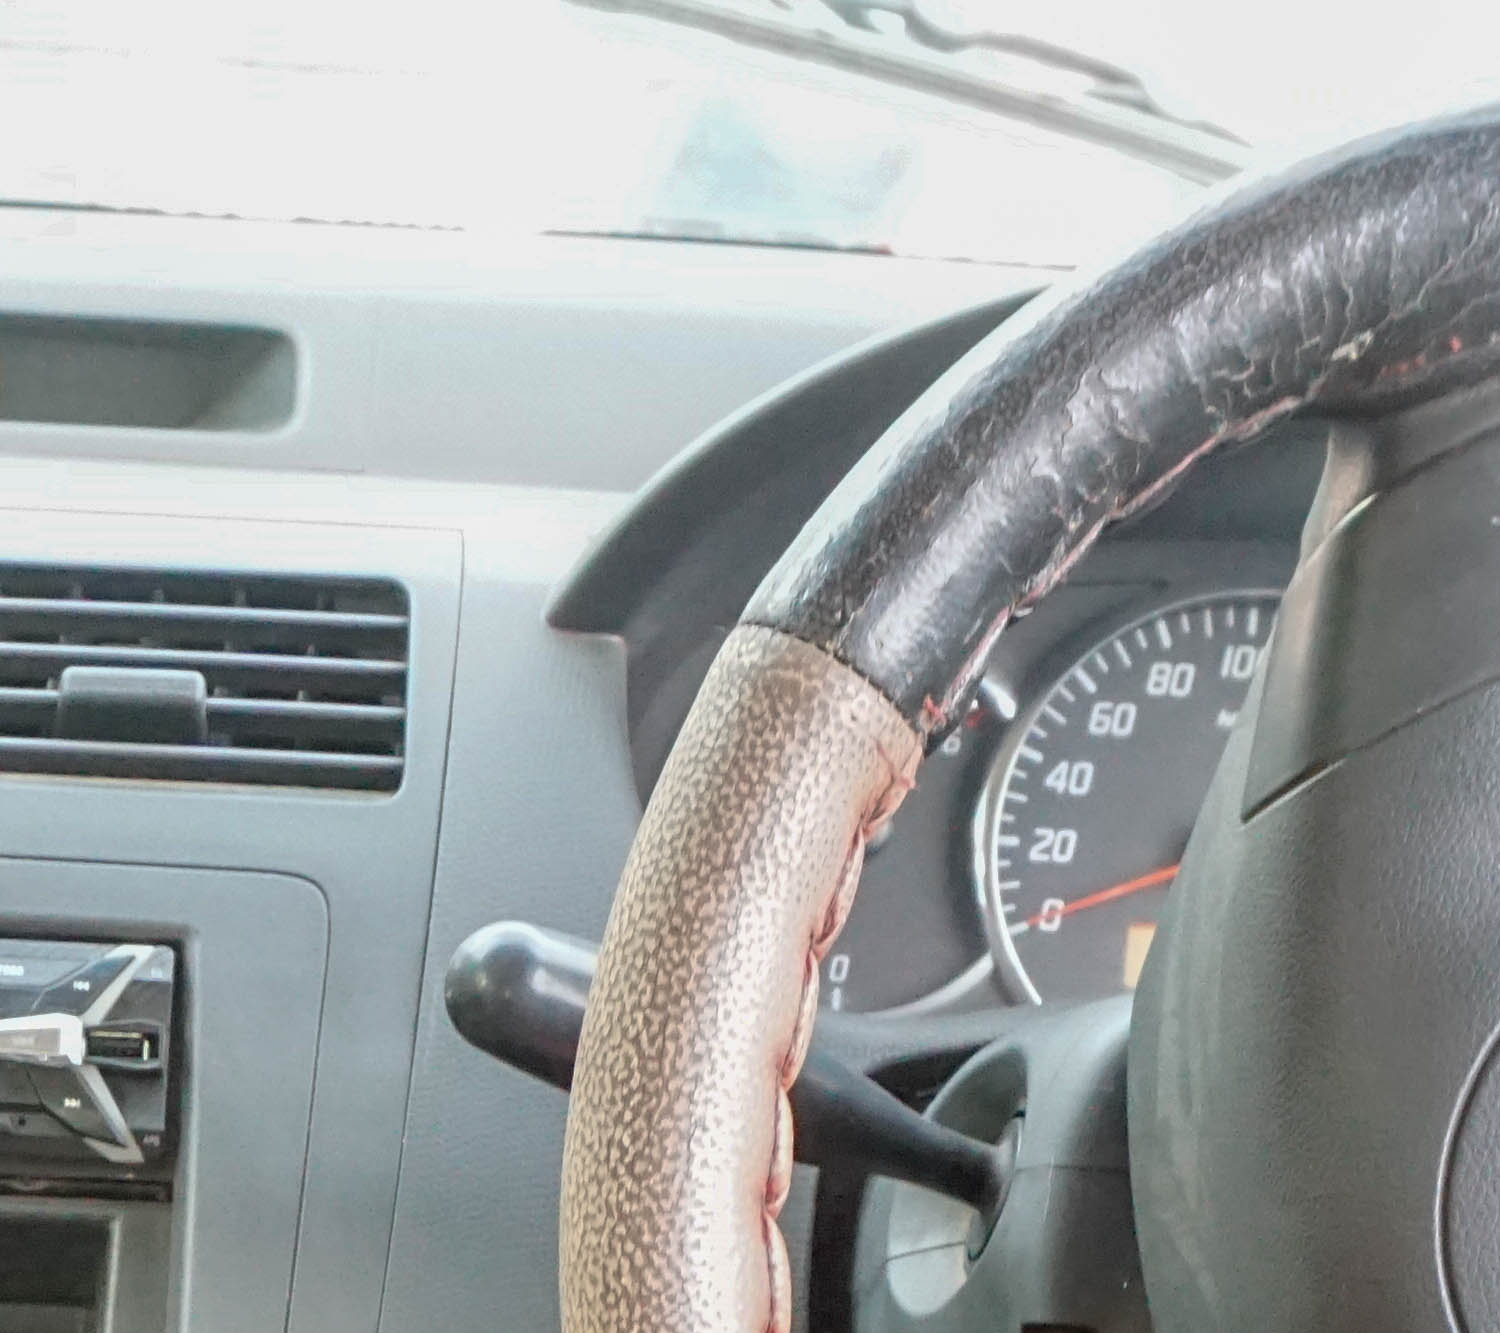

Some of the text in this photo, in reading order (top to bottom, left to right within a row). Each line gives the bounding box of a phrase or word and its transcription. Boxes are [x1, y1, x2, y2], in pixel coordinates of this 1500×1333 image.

[1146, 661, 1196, 698] 80
[1220, 644, 1264, 680] 10
[1088, 700, 1138, 738] 60
[1045, 760, 1095, 796] 40
[1029, 827, 1078, 863] 20
[1039, 898, 1065, 932] 0
[829, 954, 850, 982] 0
